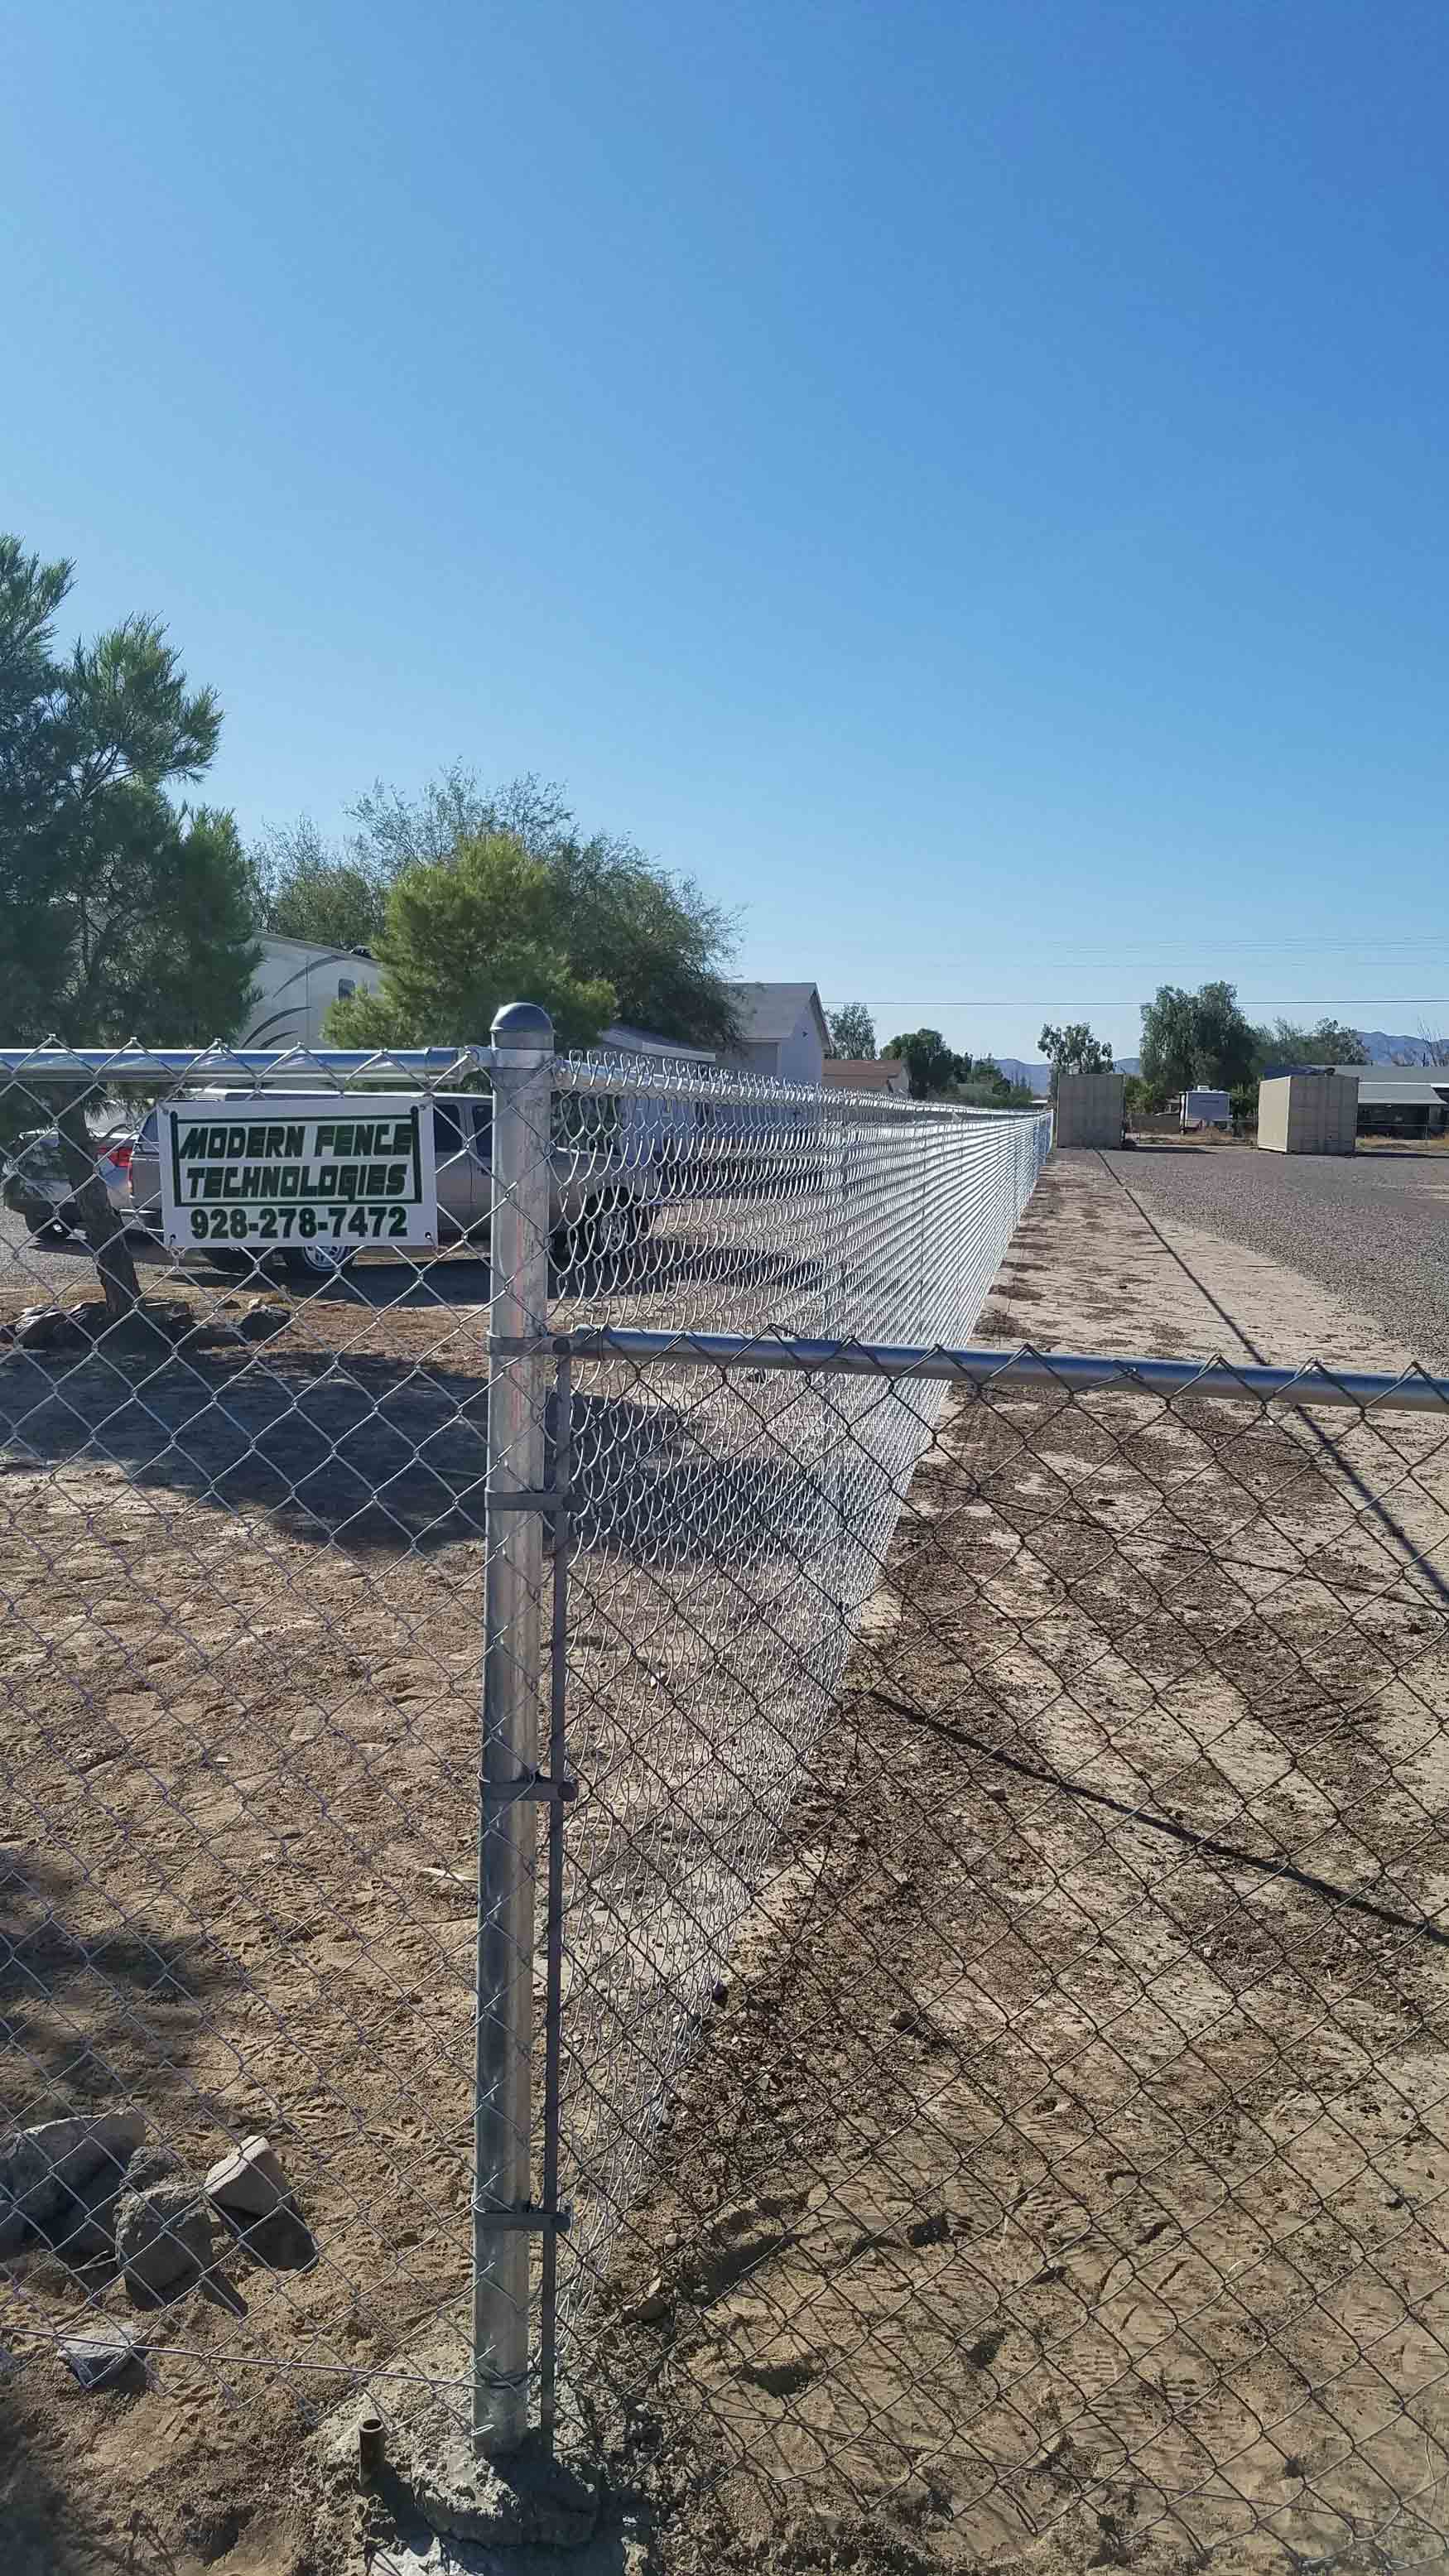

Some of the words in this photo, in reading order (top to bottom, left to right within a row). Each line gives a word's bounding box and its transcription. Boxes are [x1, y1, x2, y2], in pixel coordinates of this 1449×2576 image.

[180, 1126, 306, 1159] MODERN
[314, 1124, 413, 1158] FENCE
[186, 1163, 407, 1200] TECHNOLOGIES
[190, 1206, 408, 1240] 928-278-7472
